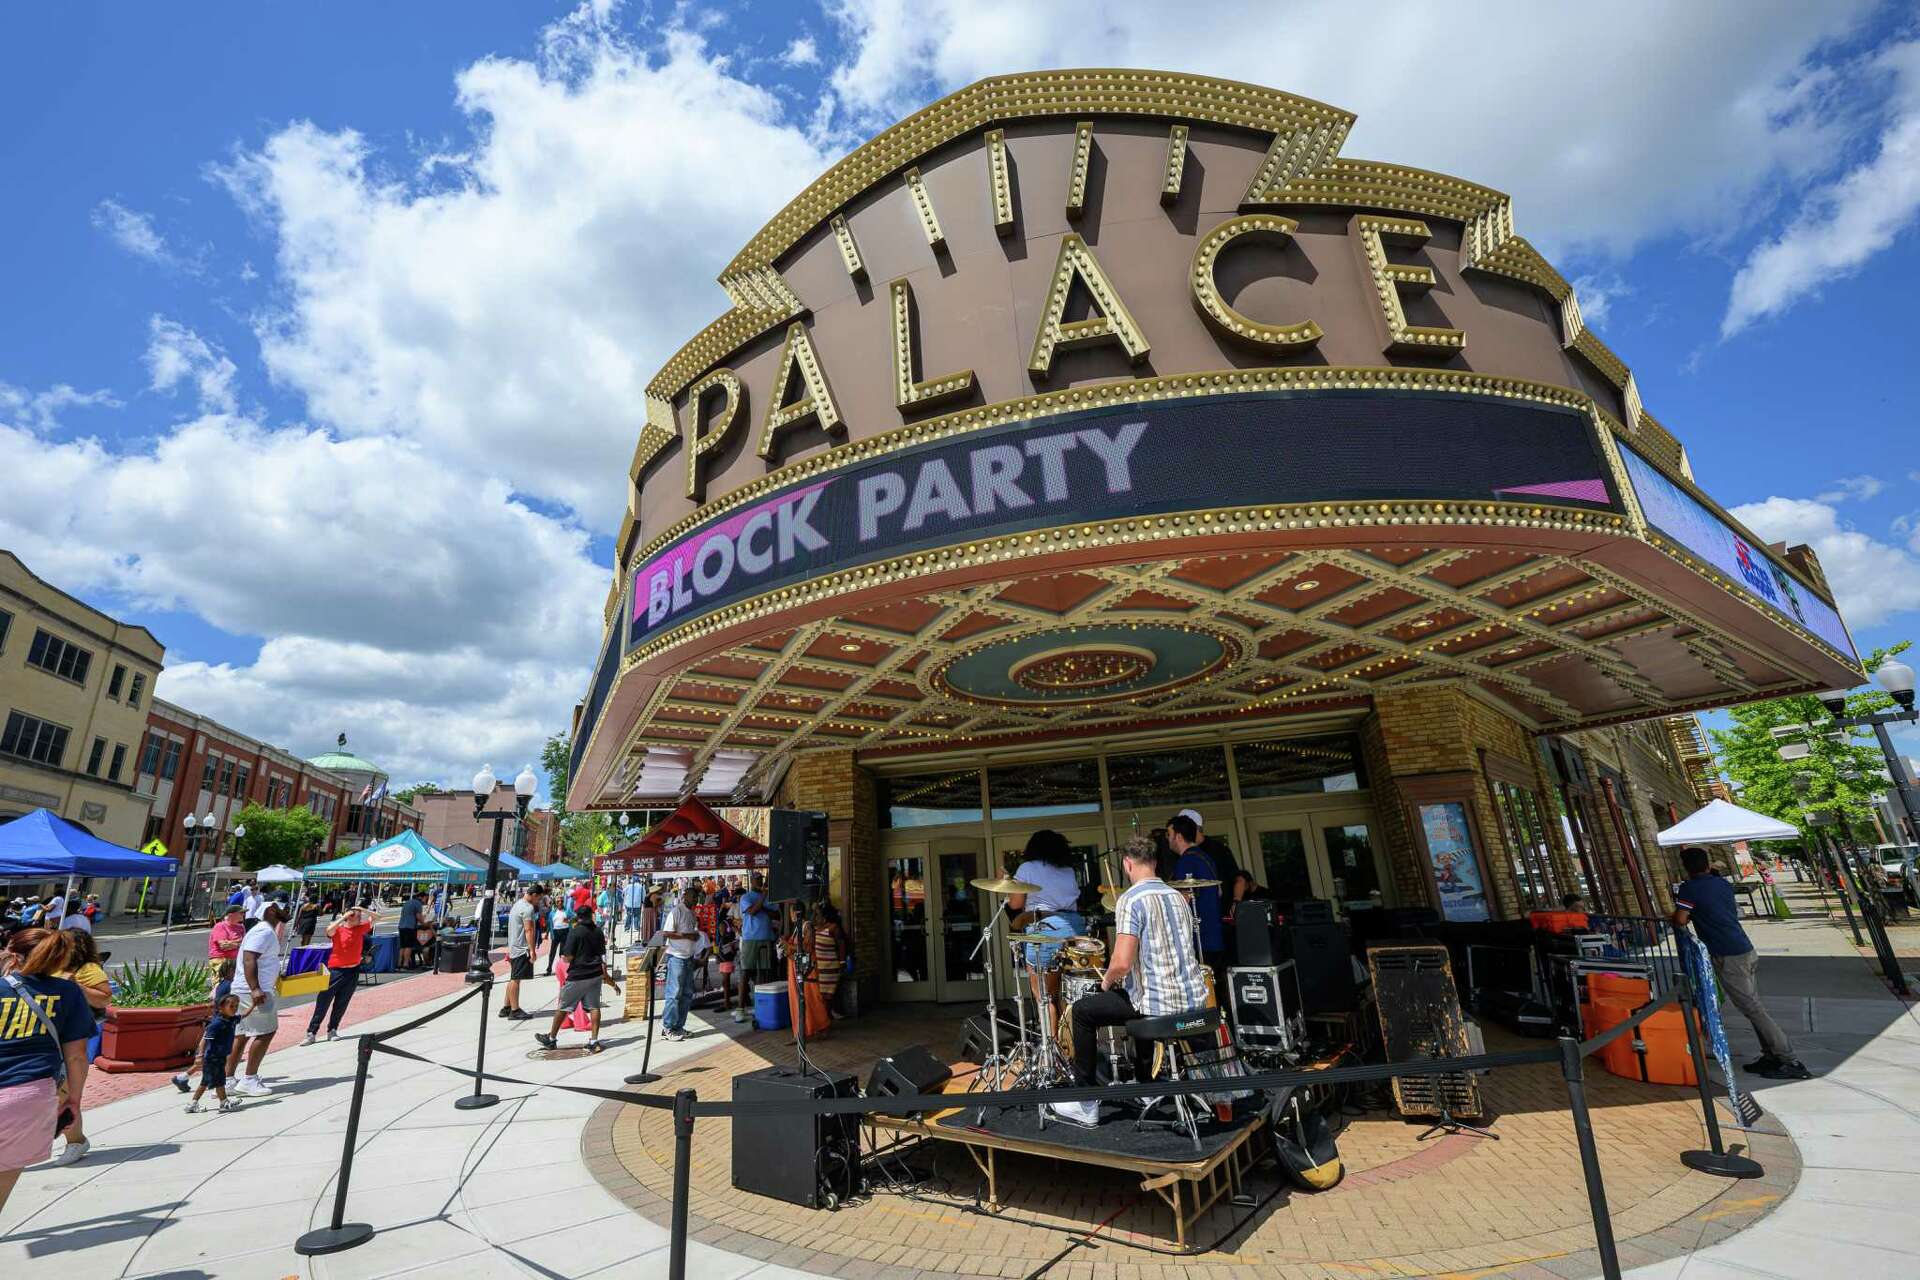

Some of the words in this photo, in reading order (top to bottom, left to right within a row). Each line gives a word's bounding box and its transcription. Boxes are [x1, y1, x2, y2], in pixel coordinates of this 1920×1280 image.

[684, 213, 1467, 502] PALACE
[648, 487, 831, 627] BLOCK
[858, 421, 1149, 542] PARTY
[664, 833, 720, 846] JAMZ
